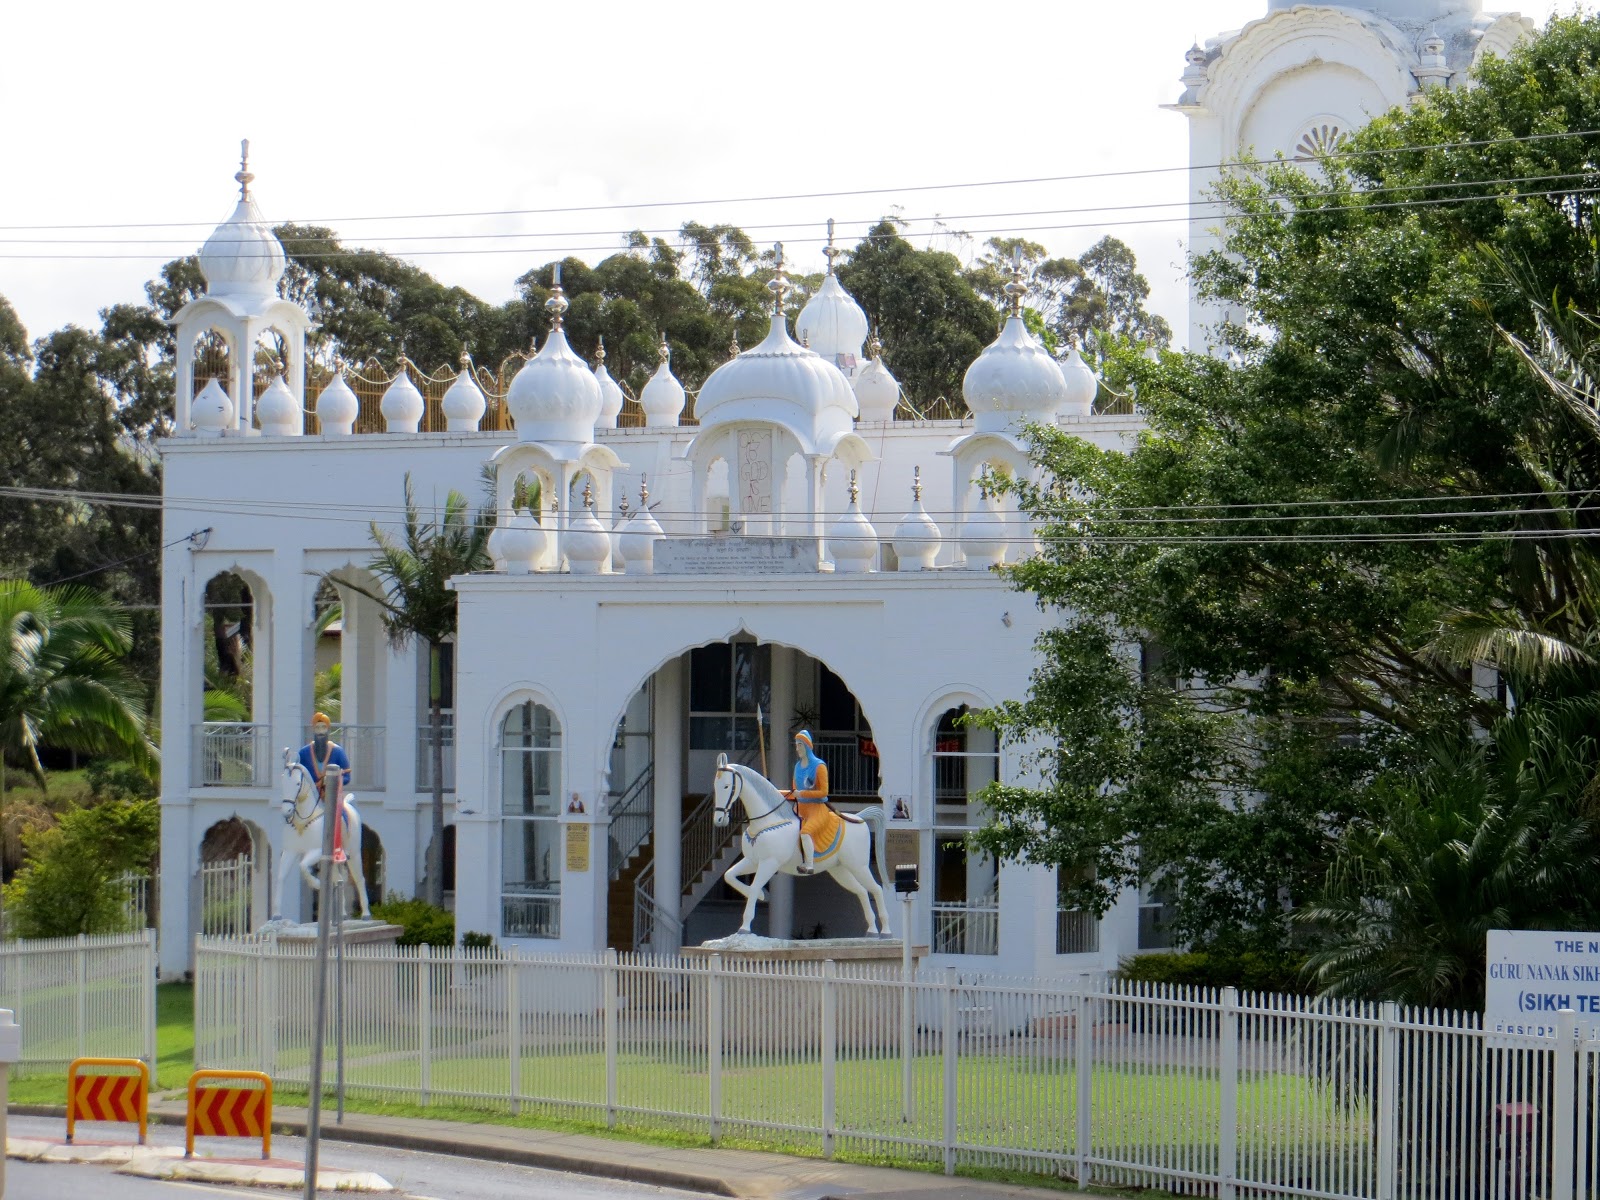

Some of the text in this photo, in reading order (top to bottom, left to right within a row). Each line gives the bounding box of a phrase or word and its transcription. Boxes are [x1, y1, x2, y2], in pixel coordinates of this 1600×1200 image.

[741, 460, 768, 481] GOD
[743, 495, 770, 513] ONE
[1555, 941, 1584, 953] THE
[1490, 963, 1524, 979] GURU
[1527, 965, 1570, 981] NANAK
[1518, 991, 1570, 1012] (SIKH
